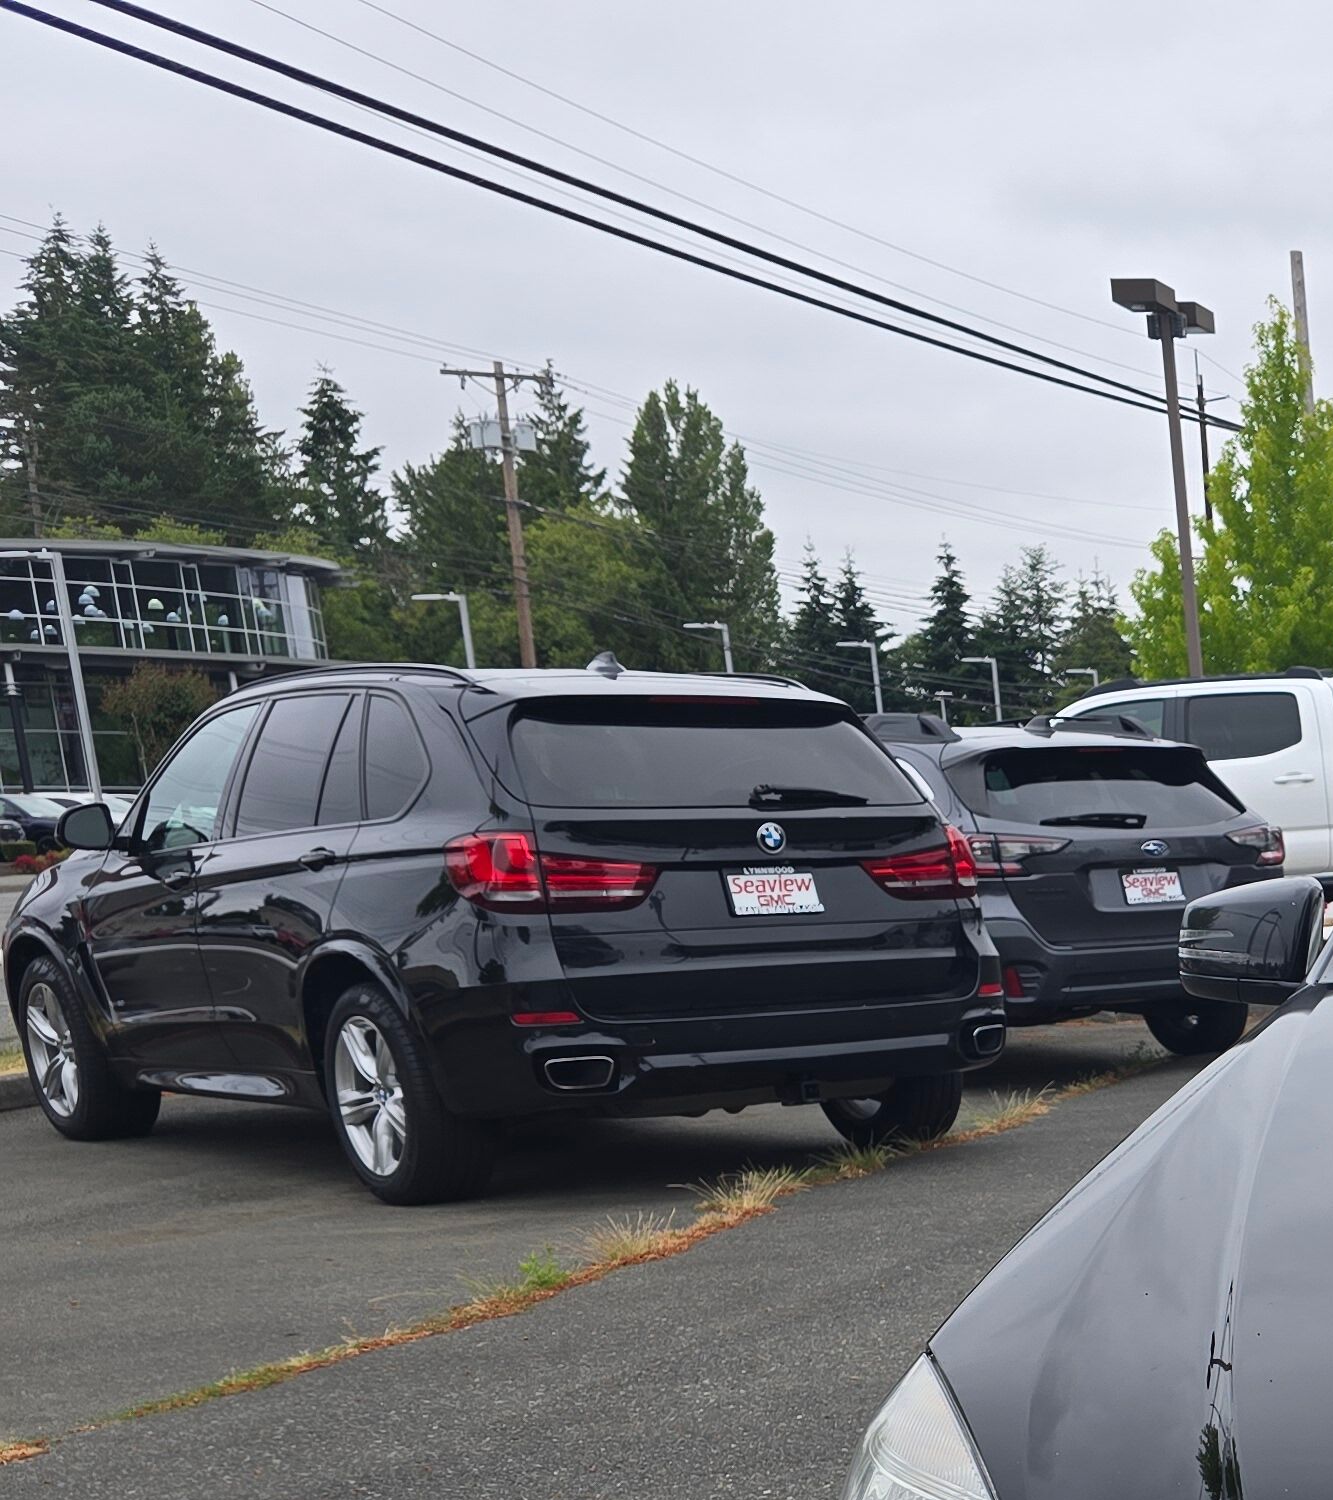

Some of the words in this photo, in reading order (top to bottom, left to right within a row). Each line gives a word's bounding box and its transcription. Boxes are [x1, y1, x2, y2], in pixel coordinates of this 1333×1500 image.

[743, 866, 795, 874] LYNNWOOD
[731, 875, 812, 893] Seaview
[1125, 874, 1176, 888] Seaview
[757, 894, 796, 906] GMC
